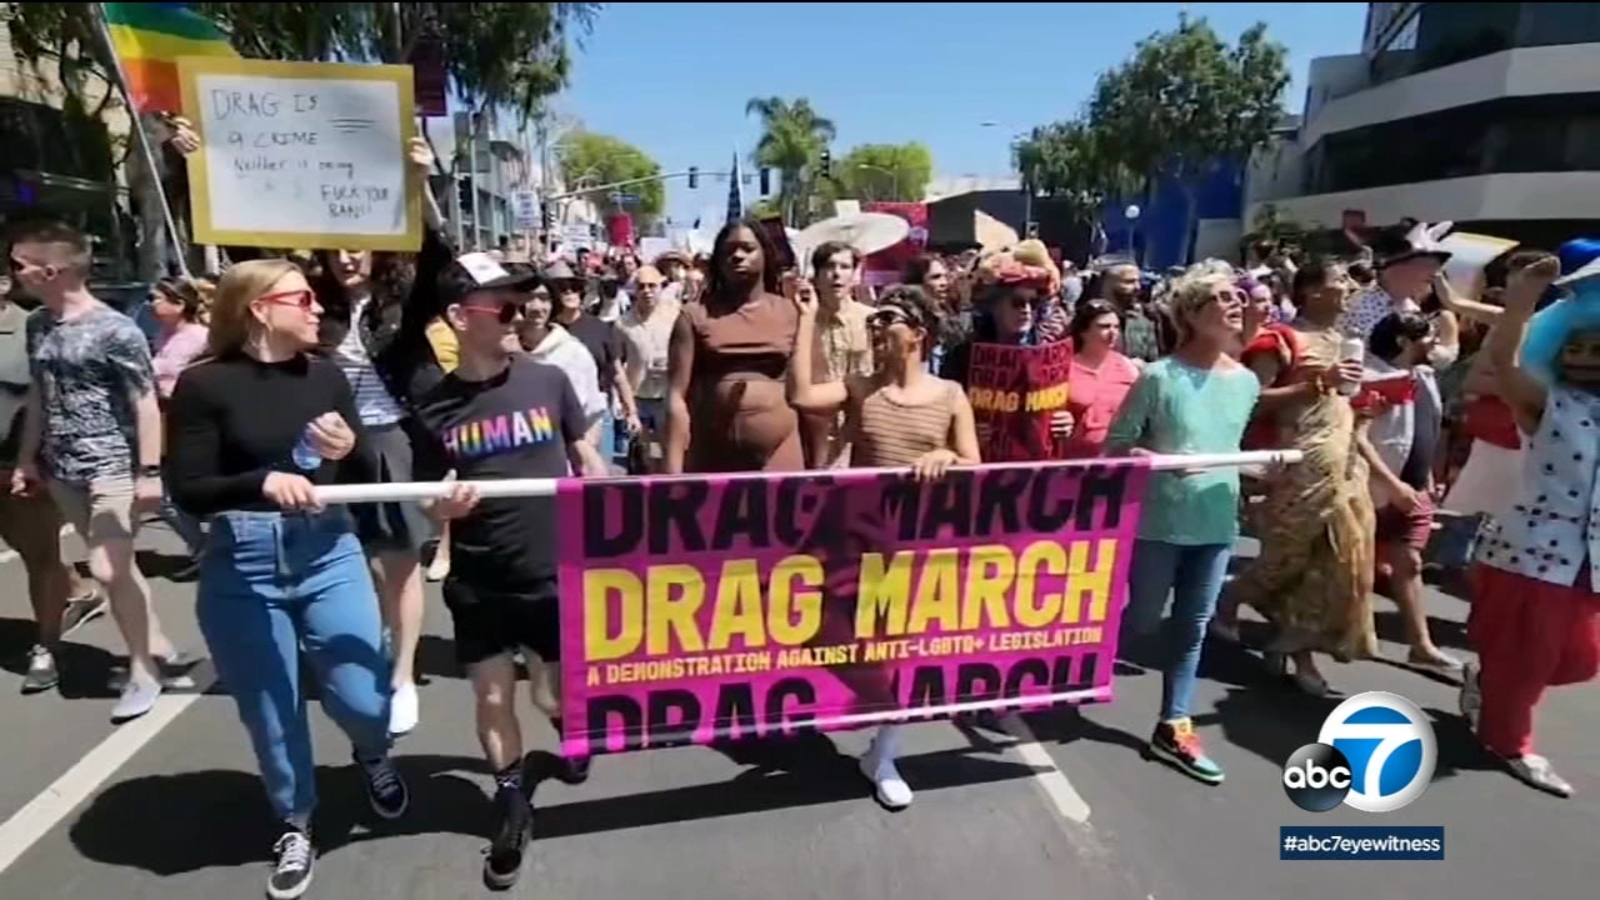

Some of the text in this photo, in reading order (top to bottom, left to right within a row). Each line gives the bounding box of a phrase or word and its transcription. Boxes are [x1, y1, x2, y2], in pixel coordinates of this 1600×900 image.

[211, 89, 279, 120] DRAG
[970, 386, 1020, 412] DRAG
[442, 407, 553, 453] HUMAN
[584, 464, 1133, 558] DRAG MARCH
[584, 539, 1118, 662] DRAG MARCH
[587, 627, 1103, 686] A DEMONSTRATION AGAINST ANTI-LGBTQ+ LEGISLATION
